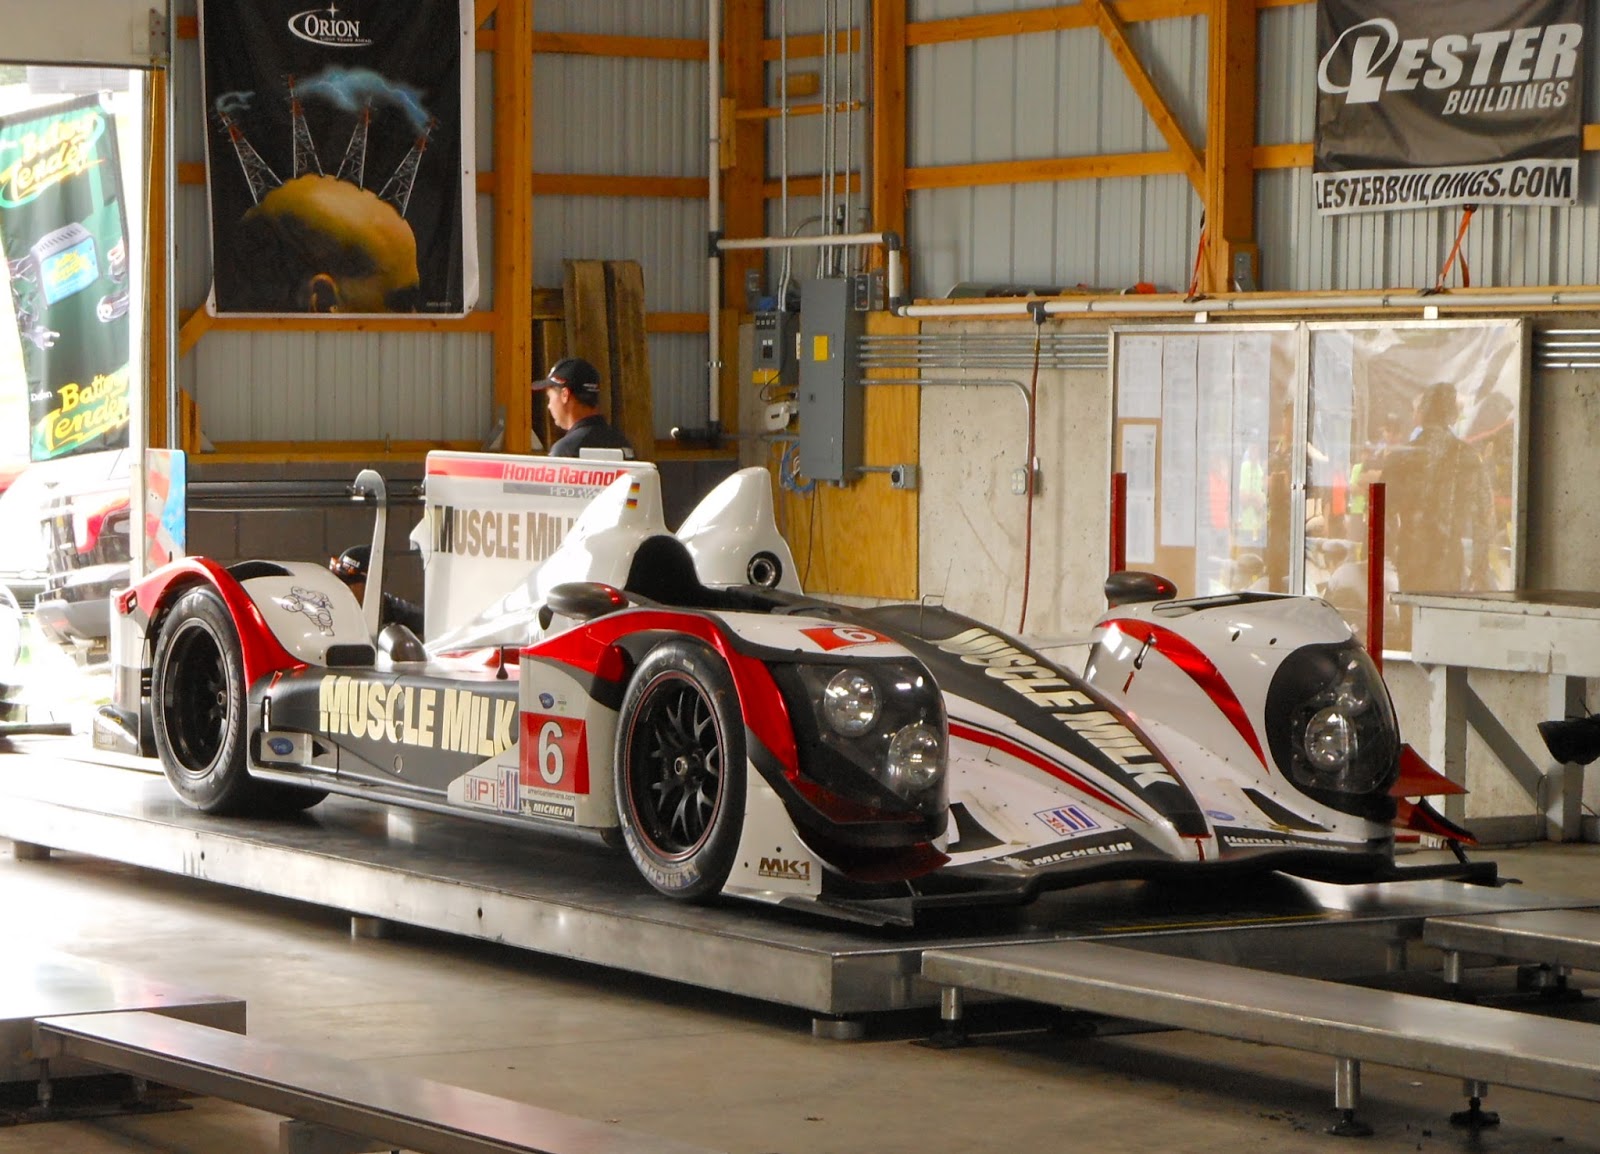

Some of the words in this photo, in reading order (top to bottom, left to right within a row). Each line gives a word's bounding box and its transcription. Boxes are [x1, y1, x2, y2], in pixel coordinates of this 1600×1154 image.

[304, 14, 360, 37] ORION
[1343, 23, 1583, 104] LESTER
[1442, 81, 1570, 116] BUILDINGS
[1316, 166, 1572, 209] LESTERBUILDINGS.COM
[503, 463, 556, 483] Honda
[550, 486, 575, 497] HPD
[434, 505, 520, 559] MUSCLE
[319, 674, 437, 748] MUSCLE
[441, 688, 517, 757] MILK
[930, 627, 1095, 708] MUSCLE
[1051, 710, 1182, 789] MILK
[538, 720, 564, 785] 6
[479, 781, 496, 803] P1
[533, 803, 574, 817] MICHELIN
[759, 857, 810, 876] MK1
[1032, 841, 1133, 866] MICHELIN
